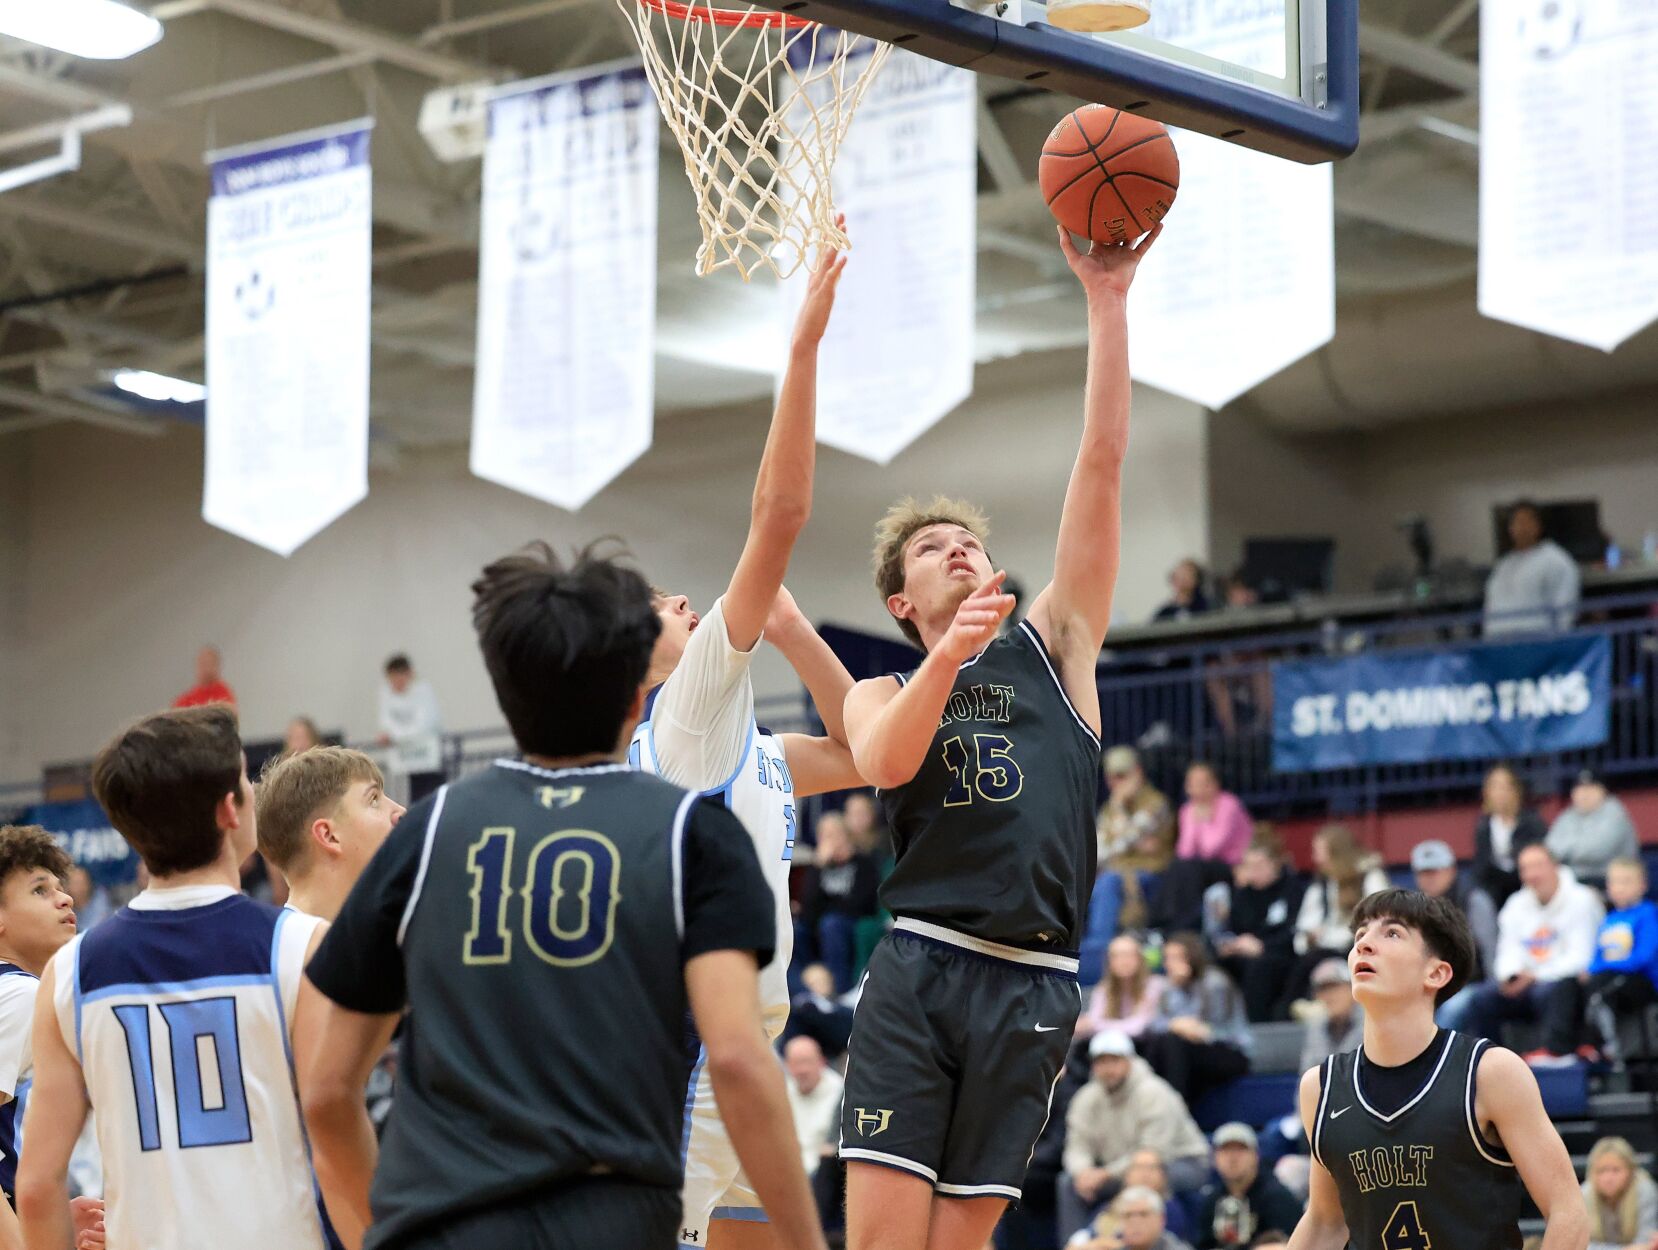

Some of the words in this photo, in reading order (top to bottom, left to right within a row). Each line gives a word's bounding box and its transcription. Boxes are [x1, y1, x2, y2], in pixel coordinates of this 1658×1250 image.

[1291, 695, 1343, 737] ST.
[1346, 682, 1493, 732] DOMINIC
[1496, 671, 1590, 722] FANS
[942, 734, 1025, 807] 15
[463, 827, 622, 967] 10
[111, 996, 253, 1152] 10
[1349, 1145, 1434, 1193] HOLT
[1381, 1200, 1432, 1250] 4
